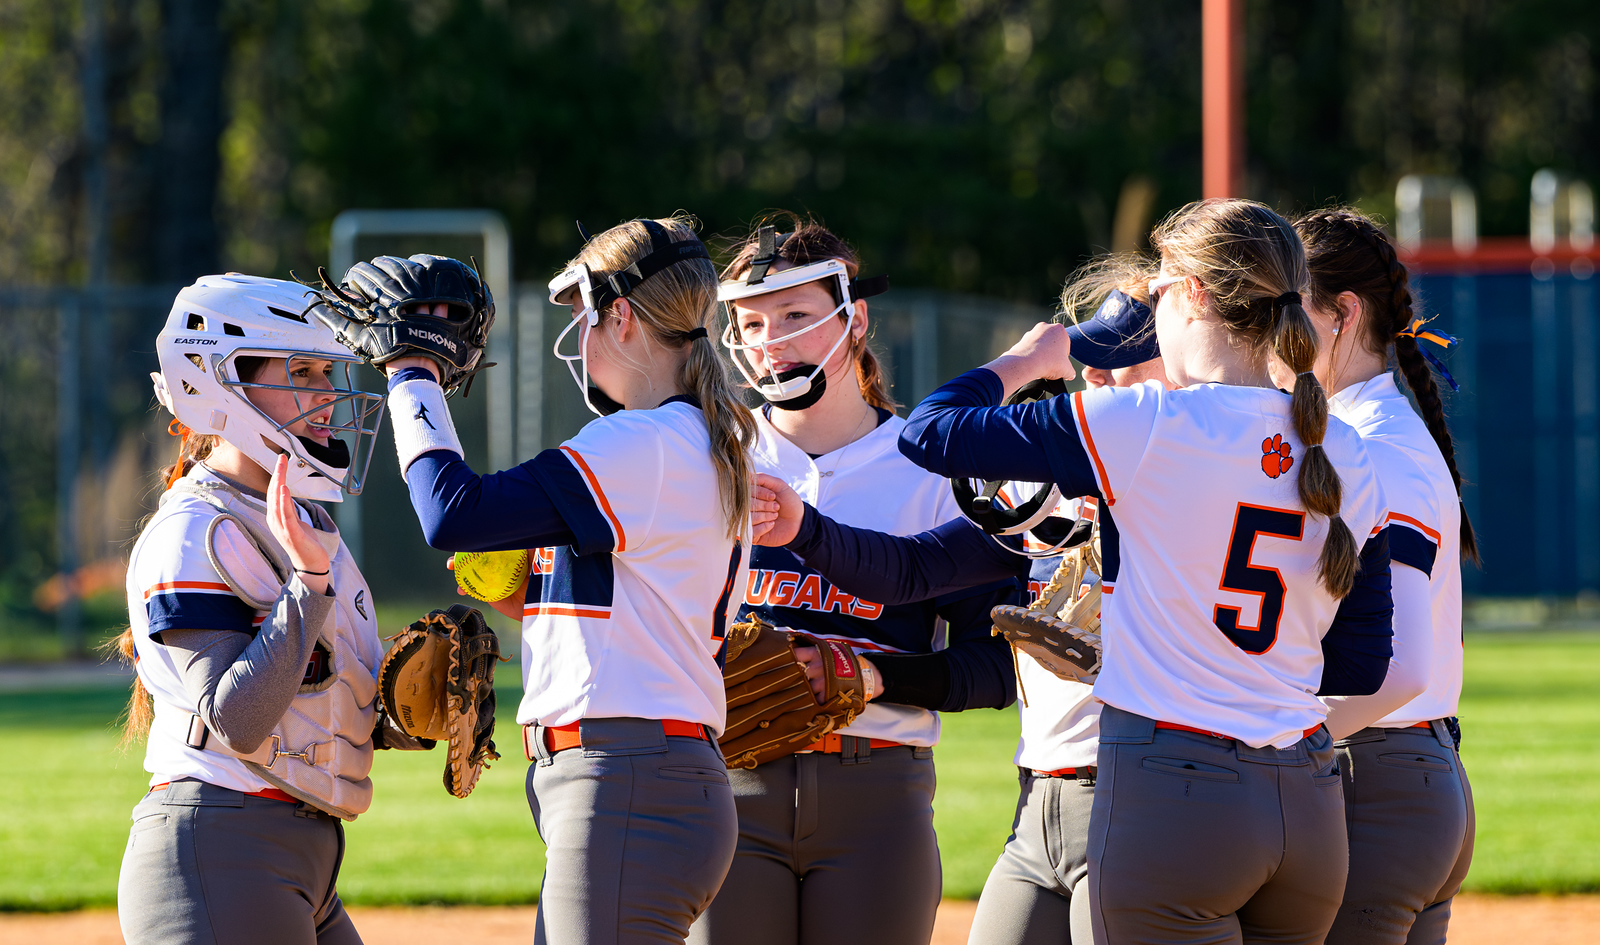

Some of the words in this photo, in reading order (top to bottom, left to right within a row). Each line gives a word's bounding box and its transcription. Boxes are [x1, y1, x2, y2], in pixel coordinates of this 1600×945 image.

[174, 337, 218, 346] EASTON
[743, 568, 885, 621] UGARS
[1212, 501, 1307, 656] 5
